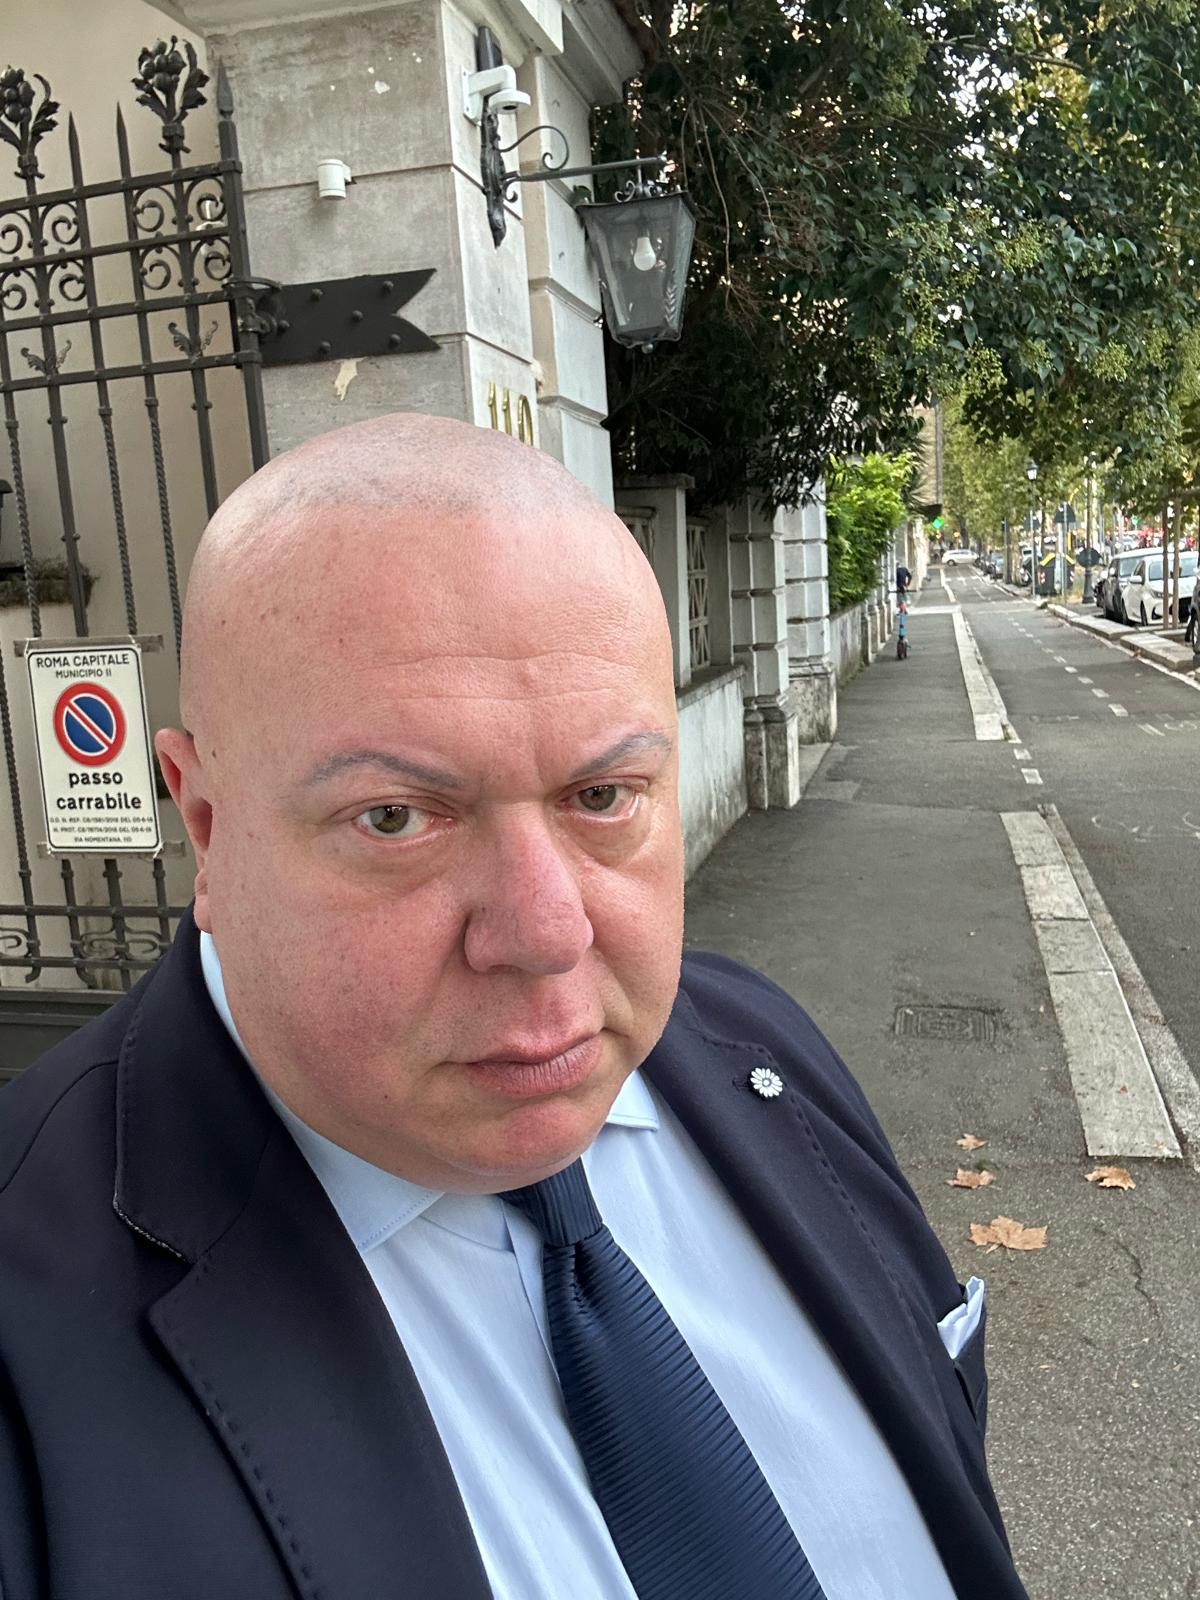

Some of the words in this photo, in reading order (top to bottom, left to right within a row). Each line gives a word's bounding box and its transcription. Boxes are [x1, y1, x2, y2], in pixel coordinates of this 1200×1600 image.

[36, 655, 70, 668] ROMA
[73, 653, 130, 666] CAPITALE
[55, 669, 103, 678] MUNICIPIO
[68, 772, 123, 788] passo
[56, 792, 142, 810] carrabile
